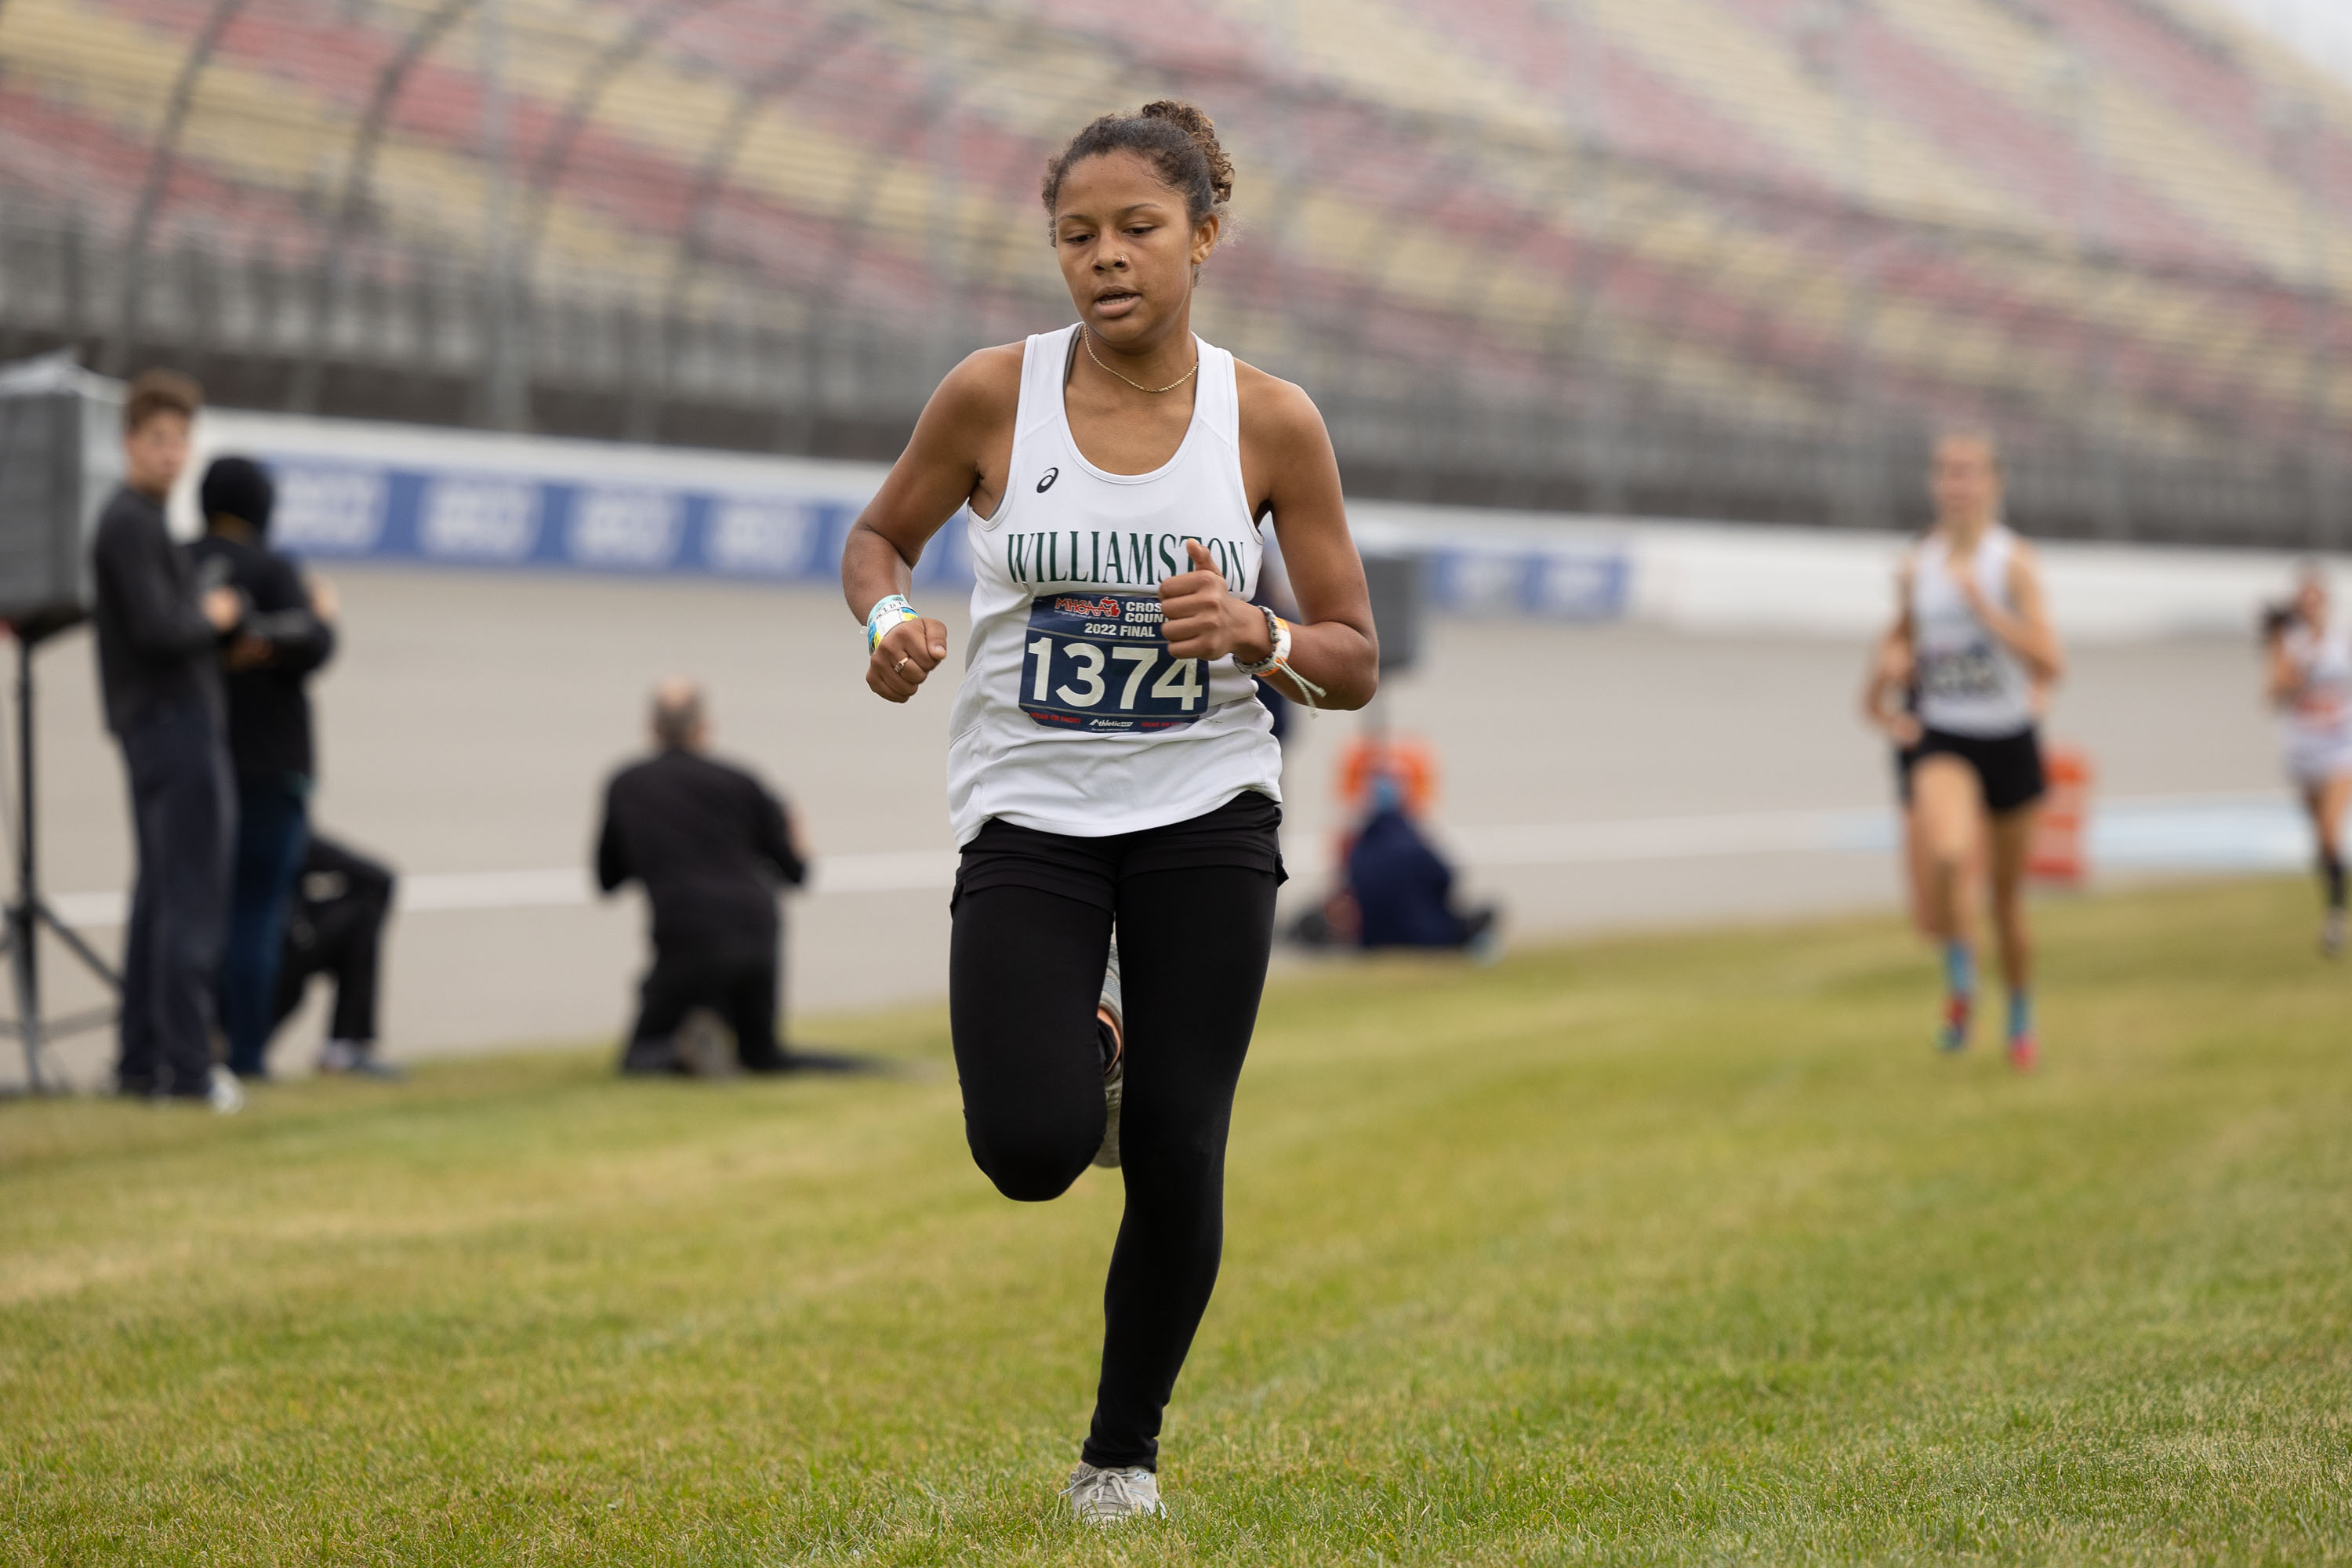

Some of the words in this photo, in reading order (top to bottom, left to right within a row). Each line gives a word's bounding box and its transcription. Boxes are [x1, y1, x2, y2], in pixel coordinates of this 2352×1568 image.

[1007, 531, 1245, 593] WILLIAMSTON
[1054, 597, 1112, 617] MHSAA
[1126, 601, 1162, 612] CROS
[1125, 612, 1169, 623] COUN
[1084, 622, 1117, 636] 2022
[1120, 625, 1156, 637] FINAL
[1028, 637, 1203, 710] 1374
